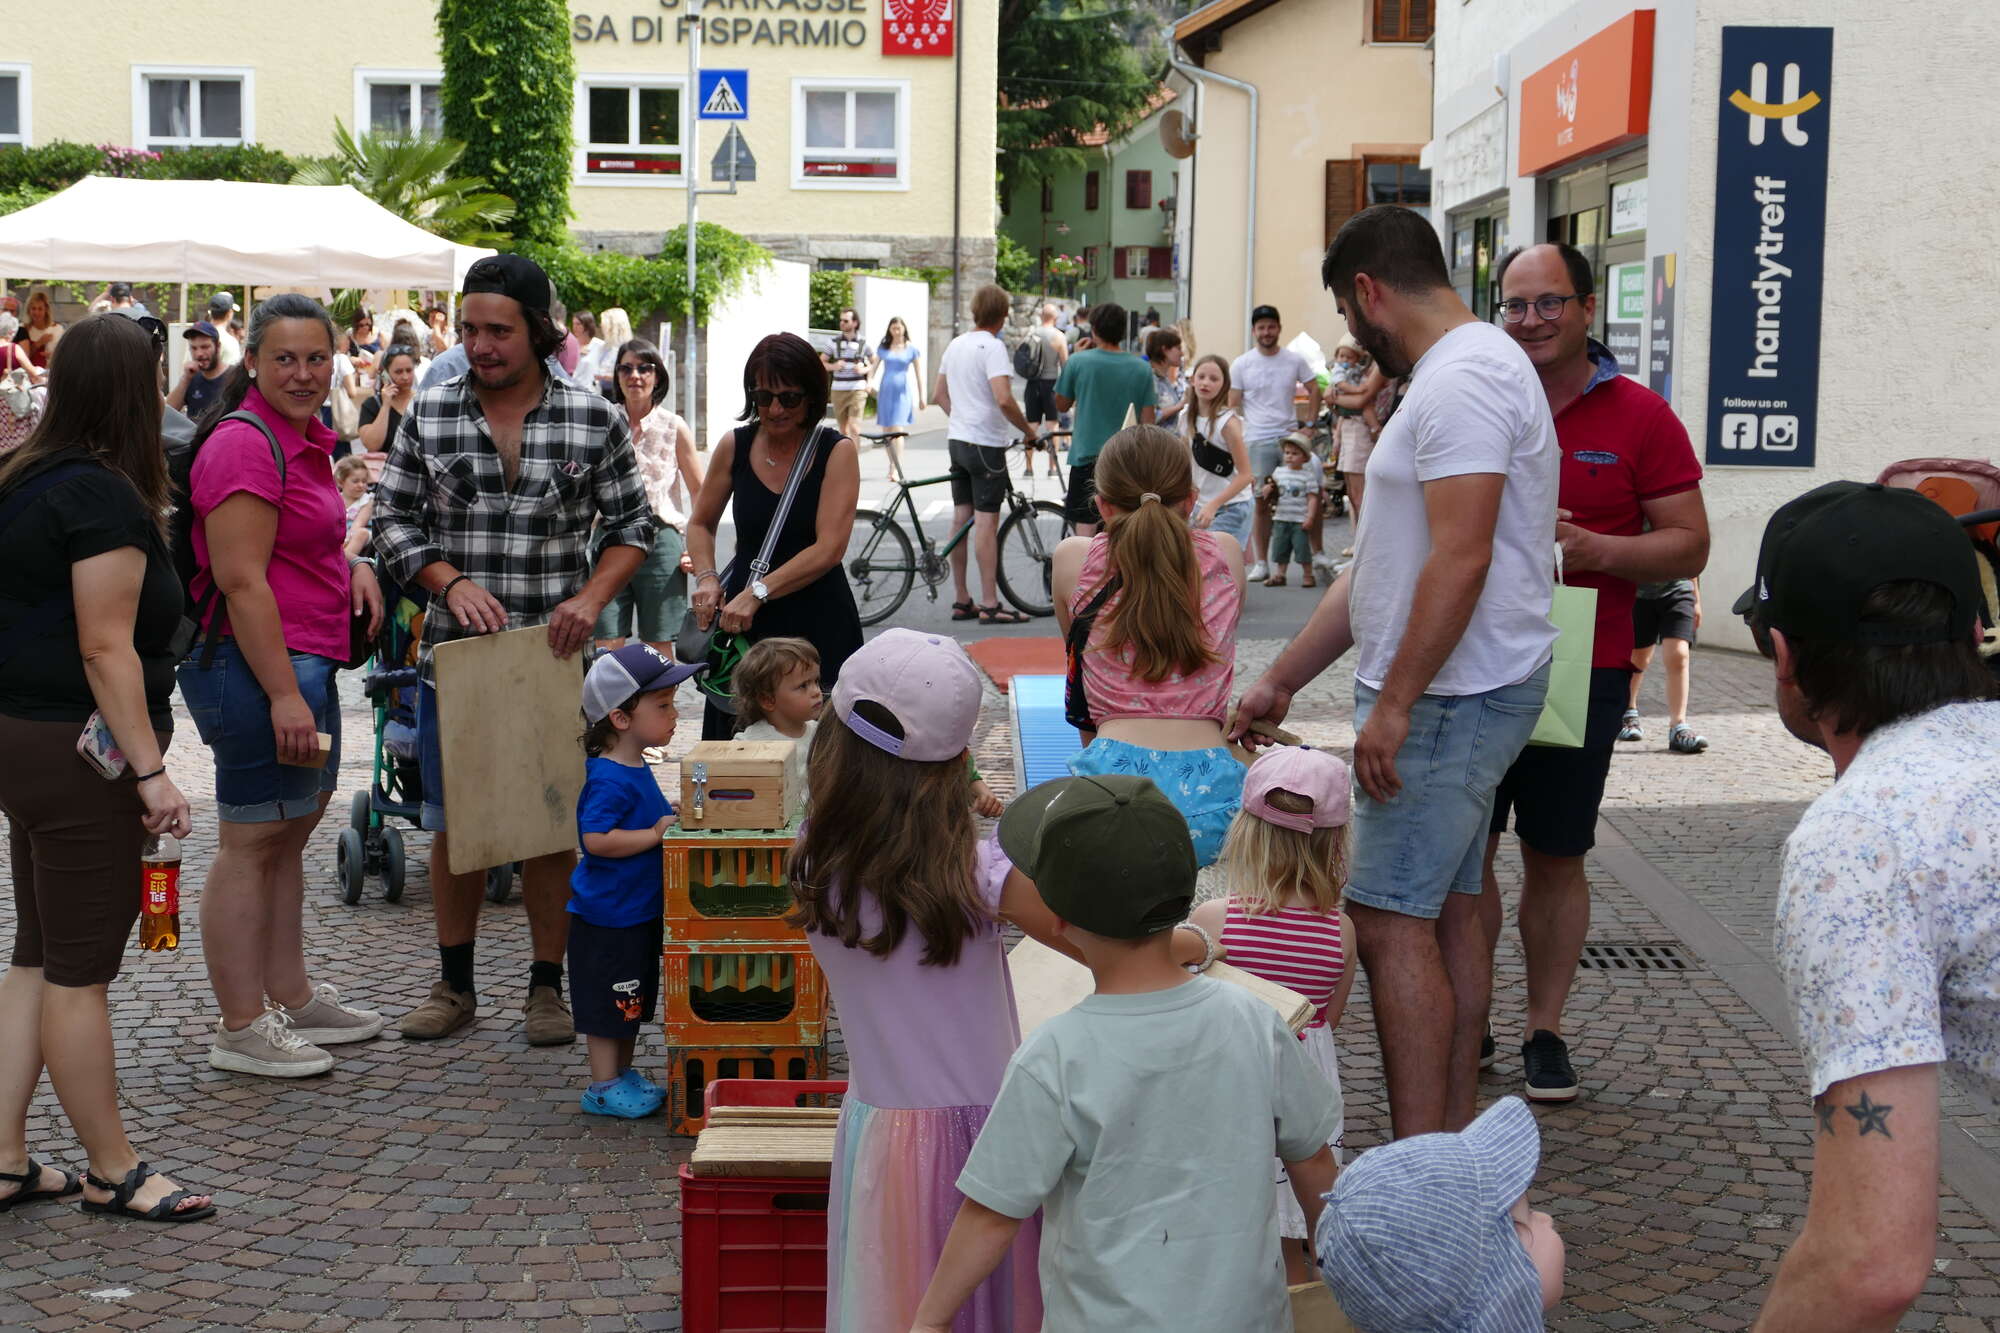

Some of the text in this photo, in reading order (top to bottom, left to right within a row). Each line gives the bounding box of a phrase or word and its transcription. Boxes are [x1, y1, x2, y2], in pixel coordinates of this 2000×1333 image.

[631, 16, 663, 42] DI
[1748, 176, 1793, 378] handytreff
[1723, 396, 1788, 409] follow us on
